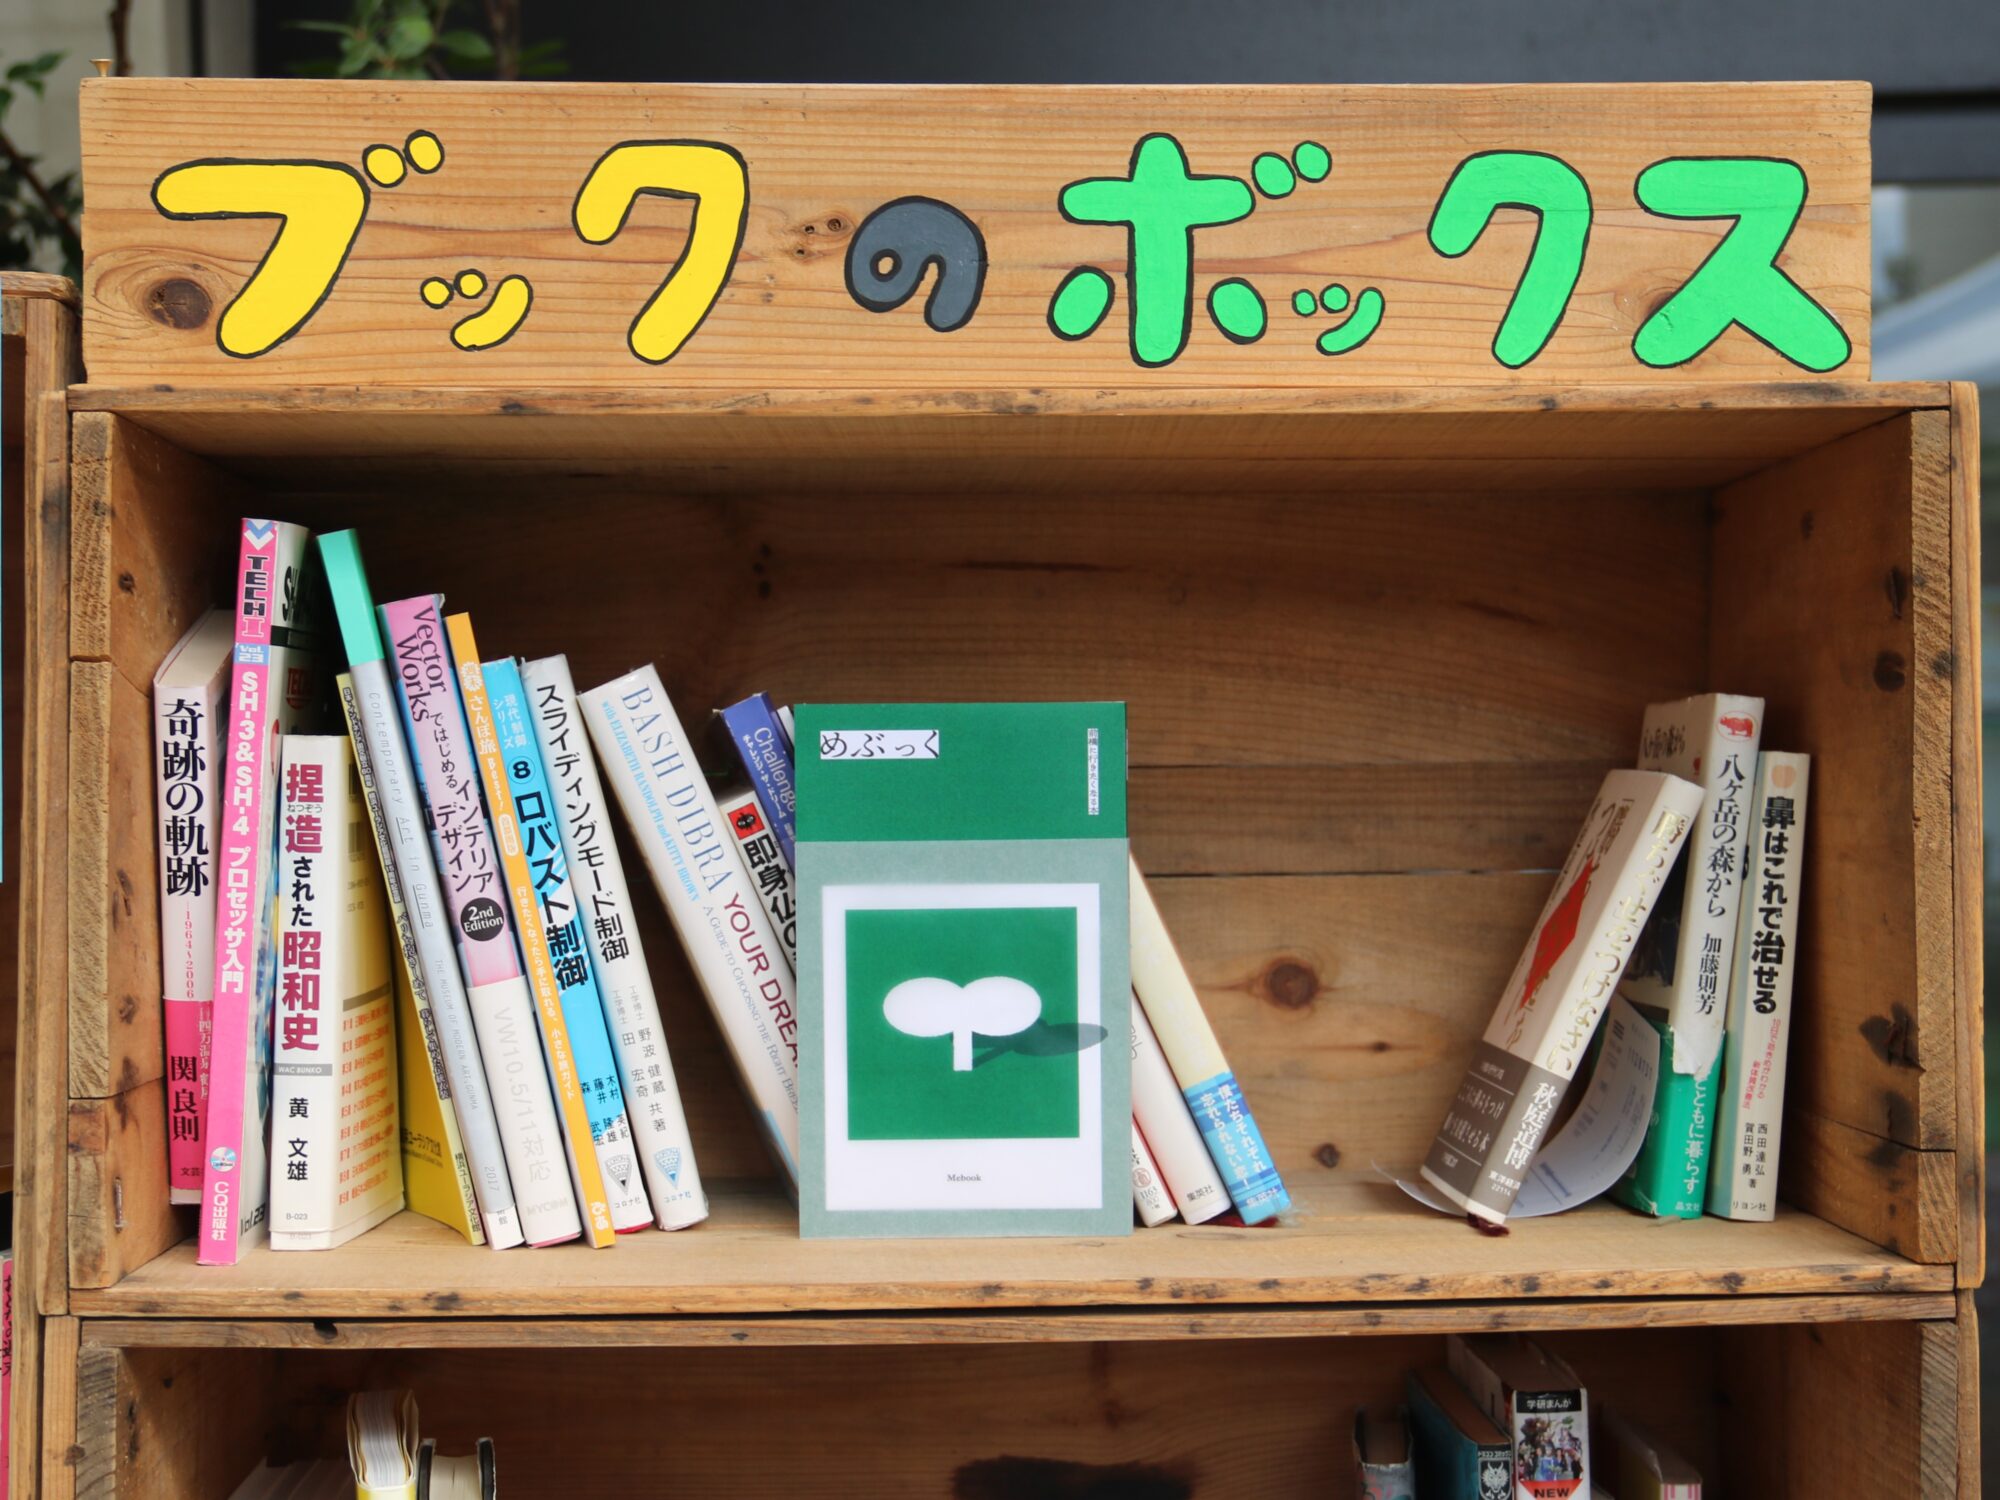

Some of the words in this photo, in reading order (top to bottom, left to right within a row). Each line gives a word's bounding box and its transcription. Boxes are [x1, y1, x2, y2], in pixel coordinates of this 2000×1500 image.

[151, 129, 1851, 373] ブックのボックス
[243, 555, 268, 617] TECH
[396, 632, 431, 723] Works
[413, 605, 447, 693] Vector
[430, 712, 457, 789] ではじめる
[470, 694, 497, 754] さんぽ旅
[493, 698, 515, 750] シリーズ
[503, 693, 527, 746] 現代制御
[820, 730, 939, 759] めぶっく
[232, 670, 259, 837] SH-3&SH-4
[510, 759, 533, 781] 8
[754, 727, 796, 813] Challenge
[163, 698, 209, 897] 奇跡の軌跡
[287, 804, 323, 814] ねつぞう
[368, 691, 404, 804] Contemporary
[399, 816, 414, 844] Art
[408, 856, 420, 872] in
[415, 883, 435, 929] Gunma
[537, 684, 630, 963] スライディングモード制御
[602, 700, 616, 720] with
[609, 715, 642, 774] ELIZABETH
[634, 771, 664, 822] RANDOLPH
[657, 818, 669, 837] and
[663, 835, 683, 867] KITTY
[677, 863, 700, 901] BROWN
[436, 801, 472, 894] デザイン
[456, 779, 493, 893] インテリア
[622, 684, 686, 781] BASH
[666, 783, 734, 894] DIBRA
[724, 893, 770, 976] YOUR
[1705, 754, 1746, 918] 八ヶ岳の森から
[221, 845, 251, 993] プロセッサ入門
[282, 764, 323, 1051] 捏造された昭和史
[468, 905, 494, 920] 2nd
[515, 790, 588, 991] ロバスト制御
[702, 905, 713, 918] A
[1752, 796, 1797, 1015] 鼻はこれで治せる
[463, 916, 504, 933] Edition
[1695, 933, 1722, 1016] 加藤則芳
[278, 1066, 295, 1074] WAC
[1218, 1084, 1267, 1173] 僕たちそれぞれ
[1504, 1082, 1559, 1170] 秋庭道博
[485, 1165, 500, 1192] 2017
[614, 1196, 642, 1209] コロナ社
[663, 1190, 692, 1204] コロナ社
[947, 1173, 982, 1183] Mebook
[1186, 1184, 1215, 1201] 集英社
[1675, 1202, 1700, 1212] 晶文社
[212, 1181, 229, 1241] CQ出版社
[286, 1212, 309, 1221] B-023
[591, 1201, 609, 1230] ぴあ
[1527, 1397, 1572, 1409] 学研まんが
[1534, 1488, 1570, 1499] NEW
